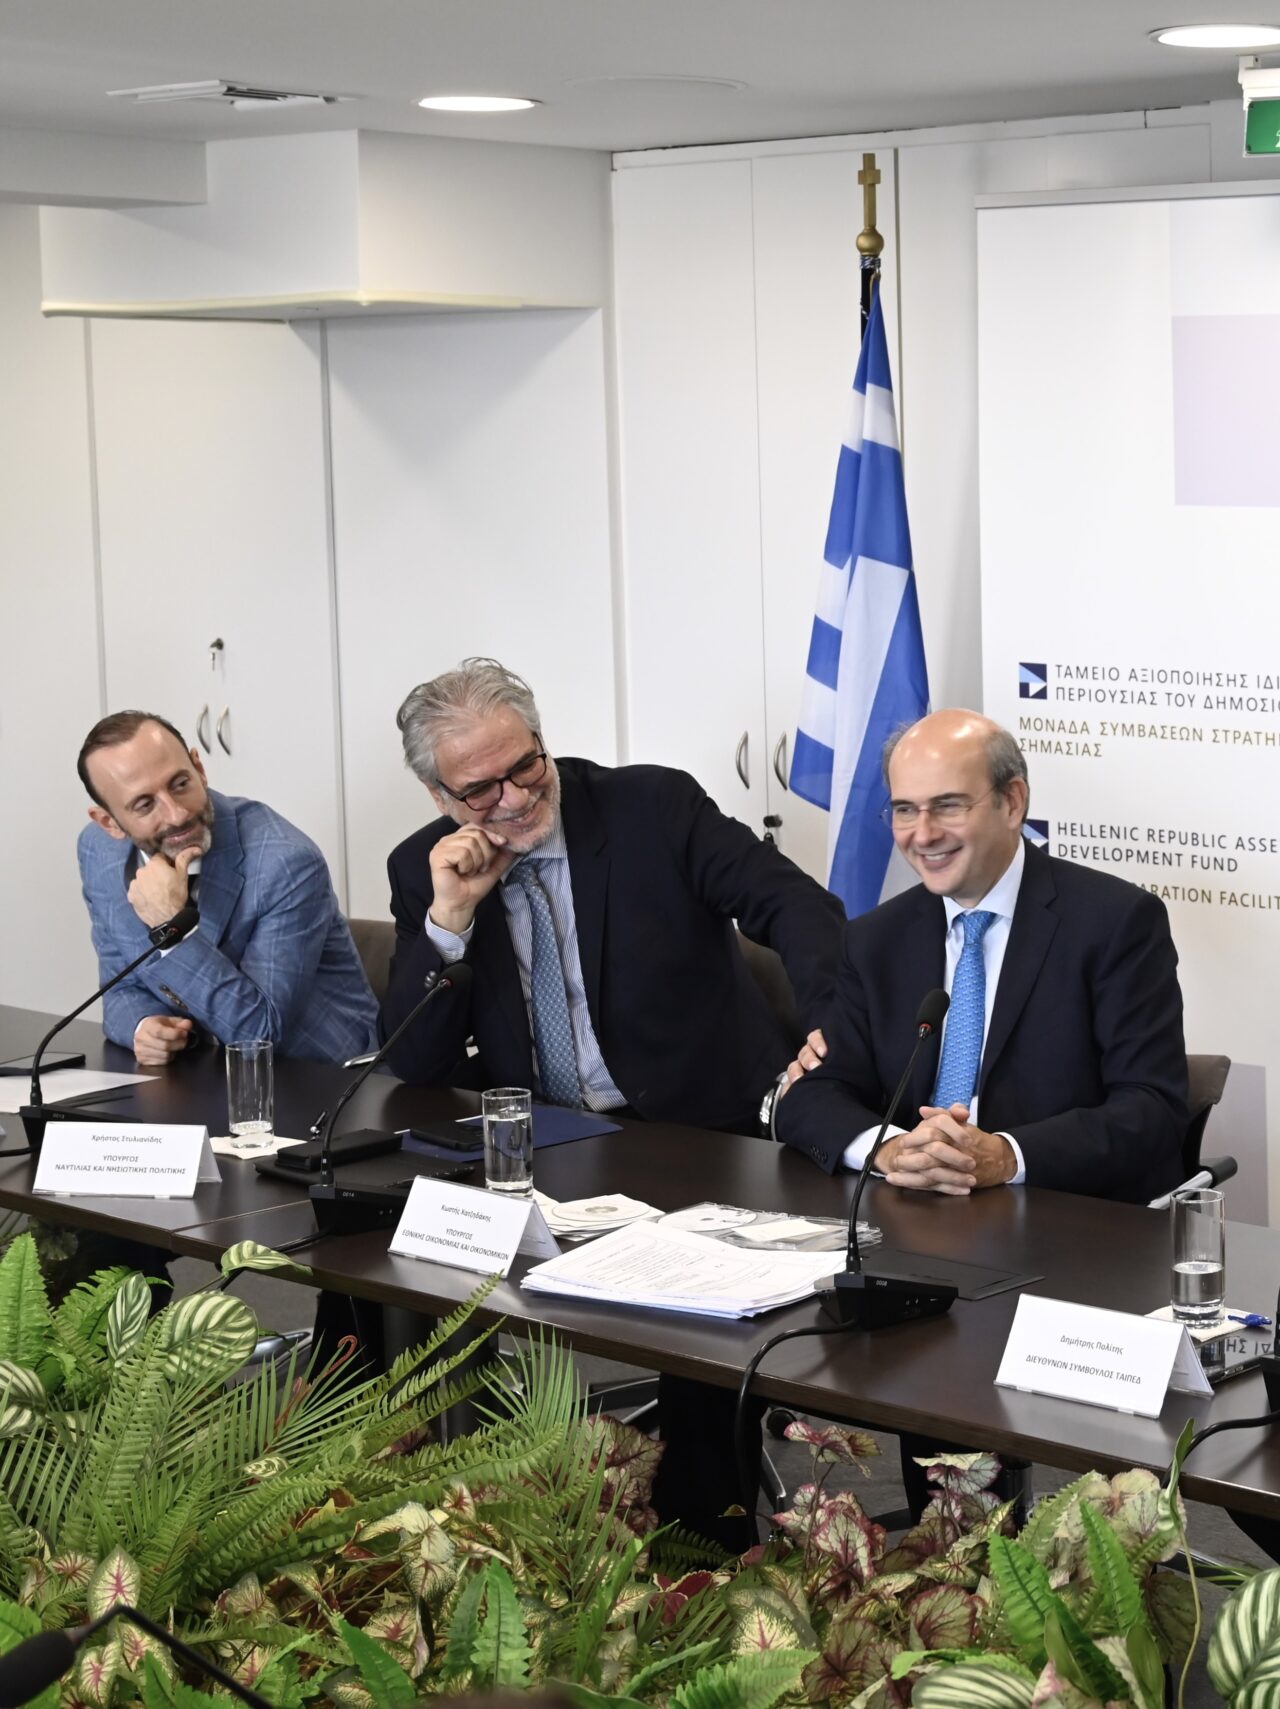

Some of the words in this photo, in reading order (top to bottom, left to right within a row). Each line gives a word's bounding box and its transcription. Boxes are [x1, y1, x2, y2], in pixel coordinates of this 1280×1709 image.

[1055, 664, 1120, 681] ΤΑΜΕΙΟ
[1128, 668, 1248, 688] ΑΞΙΟΠΟΙΗΣΗΣ
[1056, 687, 1158, 706] ΠΕΡΙΟΥΣΙΑΣ
[1165, 691, 1196, 708] ΤΟΥ
[1019, 717, 1090, 734] ΜΟΝΑΔΑ
[1100, 722, 1203, 742] ΣΥΜΒΑΣΕΩΝ
[1019, 738, 1102, 757] ΣΗΜΑΣΙΑΣ
[1058, 822, 1139, 841] HELLENIC
[1148, 828, 1227, 849] REPUBLIC
[1058, 843, 1183, 867] DEVELOPMENT
[1192, 854, 1238, 872] FUND
[1139, 882, 1212, 903] RATION
[446, 1228, 472, 1240] ΥΠΟΥΡΓΟΣ
[461, 1243, 470, 1251] ΚΑΙ
[1060, 1335, 1094, 1349] Δημήτρης
[1096, 1341, 1124, 1355] Πολίτης
[1026, 1354, 1068, 1369] ΔΙΕΥΘΥΝΩΝ
[1069, 1363, 1114, 1378] ΣΥΜΒΟΥΛΟΣ
[1116, 1373, 1141, 1384] ΤΑΙΠΕΔ
